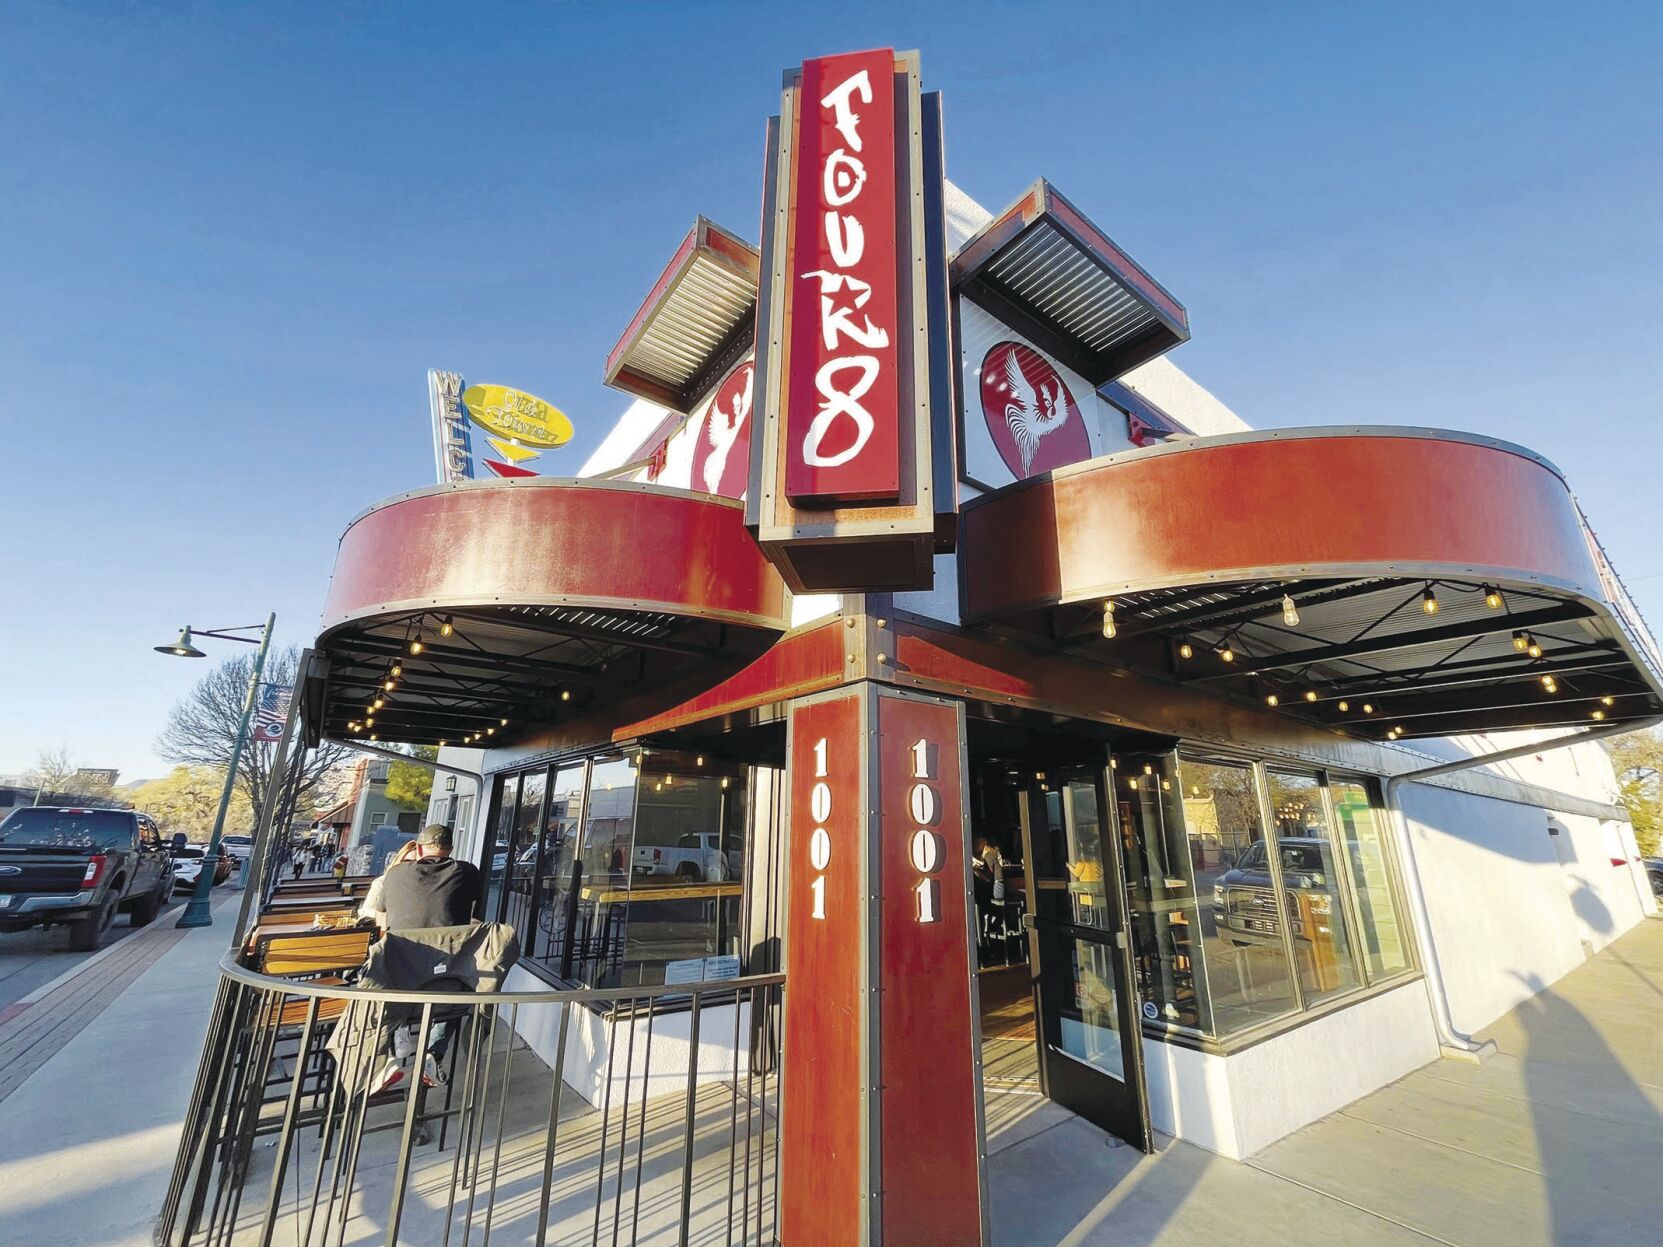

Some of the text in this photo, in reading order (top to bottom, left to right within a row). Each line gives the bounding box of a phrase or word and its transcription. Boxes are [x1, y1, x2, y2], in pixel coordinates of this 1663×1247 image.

[434, 369, 466, 482] WELC
[486, 405, 545, 438] Town
[810, 737, 832, 920] 1001
[910, 738, 937, 923] 1001
